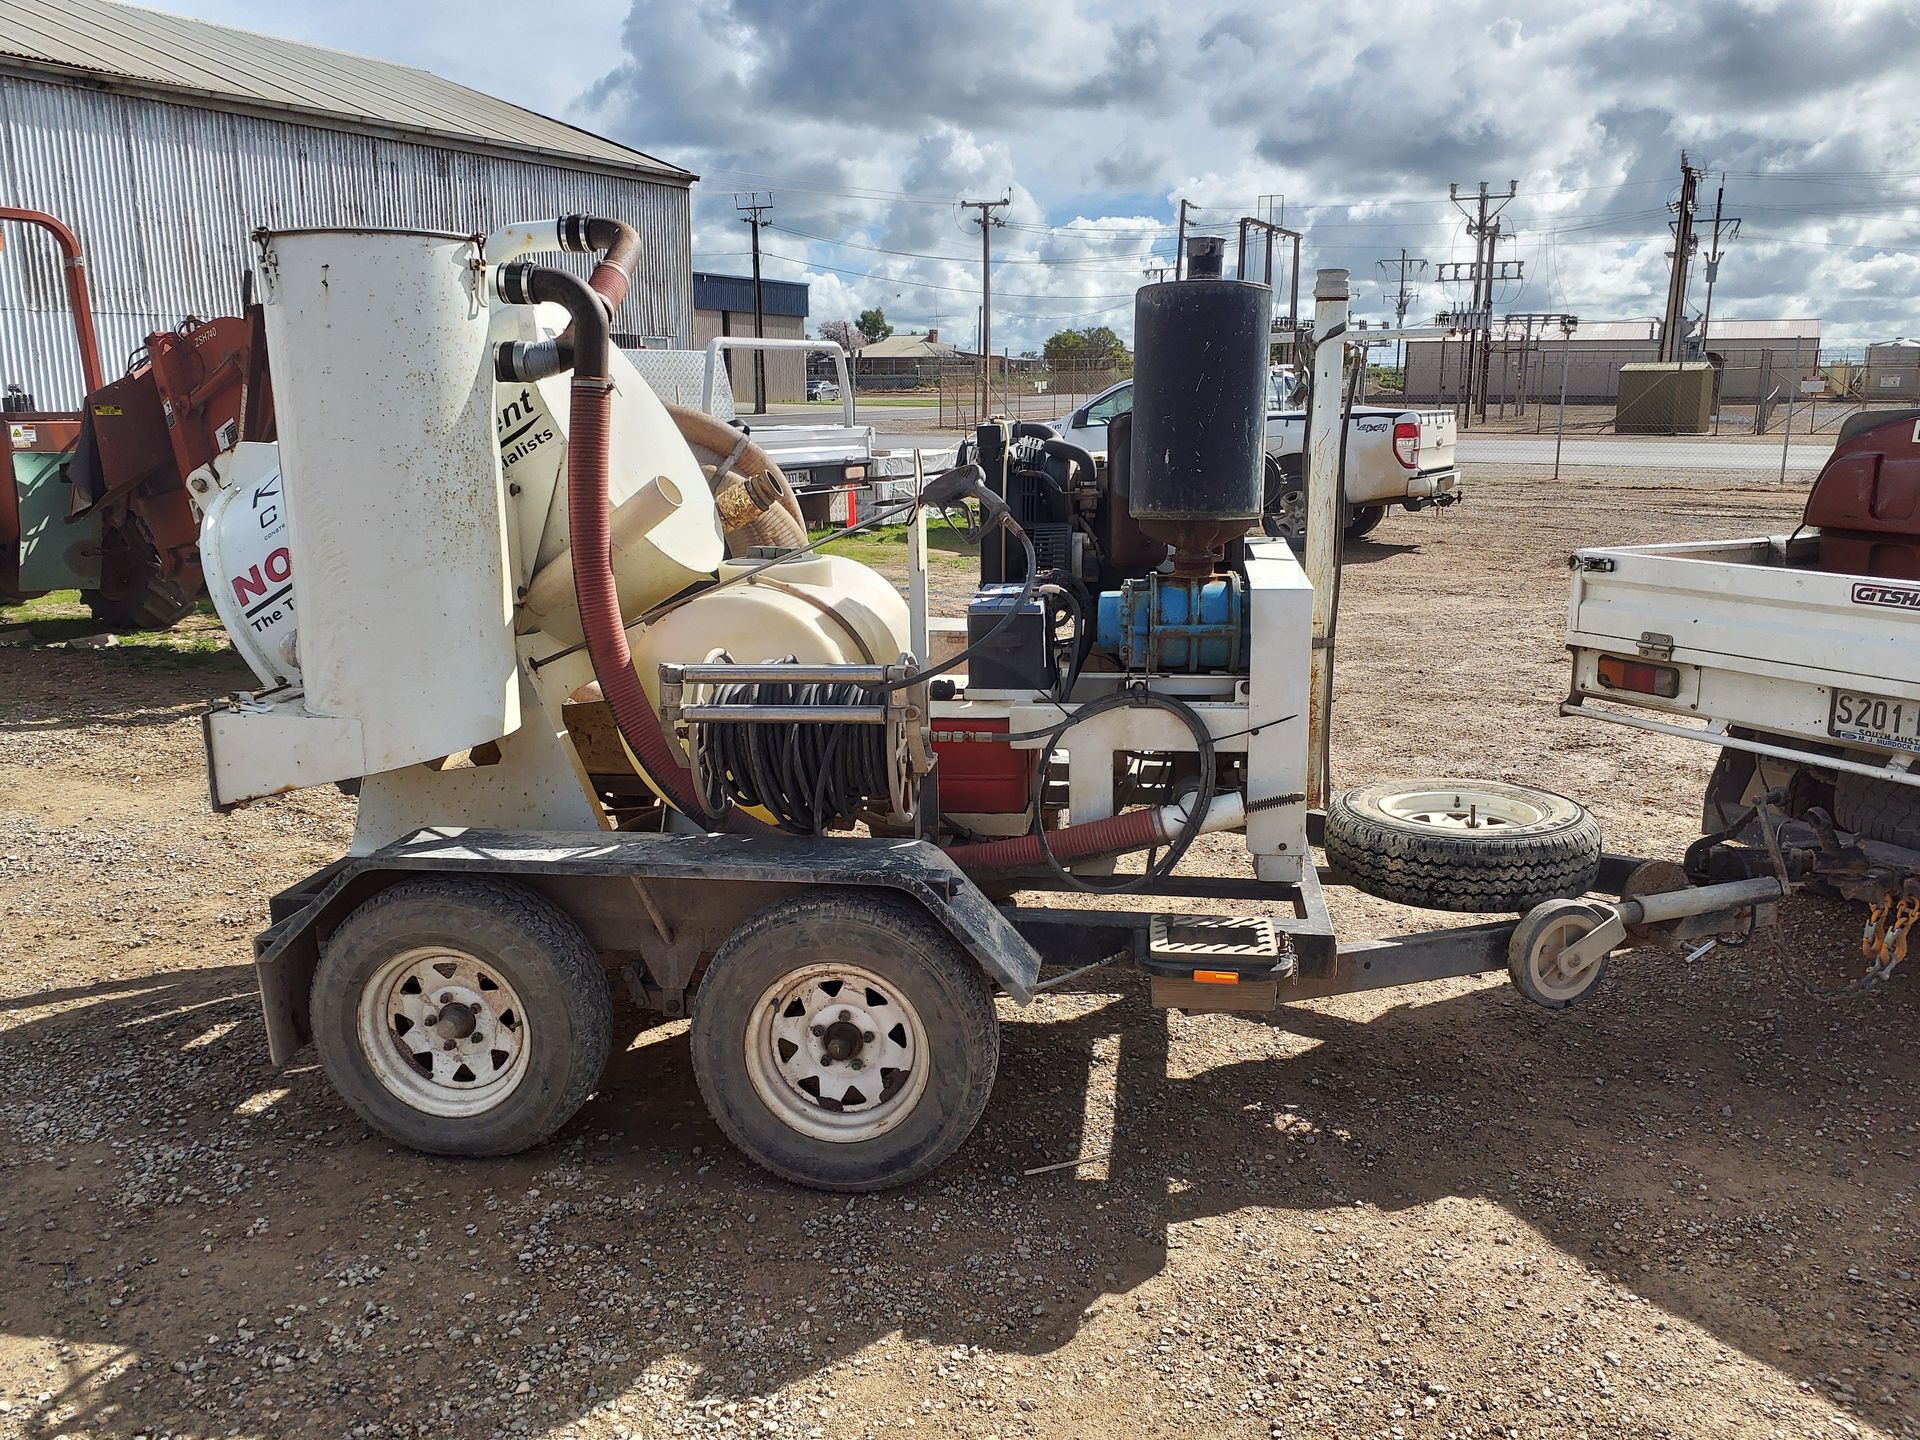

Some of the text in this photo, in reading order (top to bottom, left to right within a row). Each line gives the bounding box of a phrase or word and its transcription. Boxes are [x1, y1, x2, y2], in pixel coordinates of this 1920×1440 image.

[498, 388, 534, 434] nt
[502, 429, 553, 470] ialists
[264, 523, 286, 541] CONSTR
[231, 547, 292, 608] NO
[251, 598, 295, 632] The T
[1876, 739, 1912, 750] MURDOCK
[1894, 735, 1920, 745] AUST
